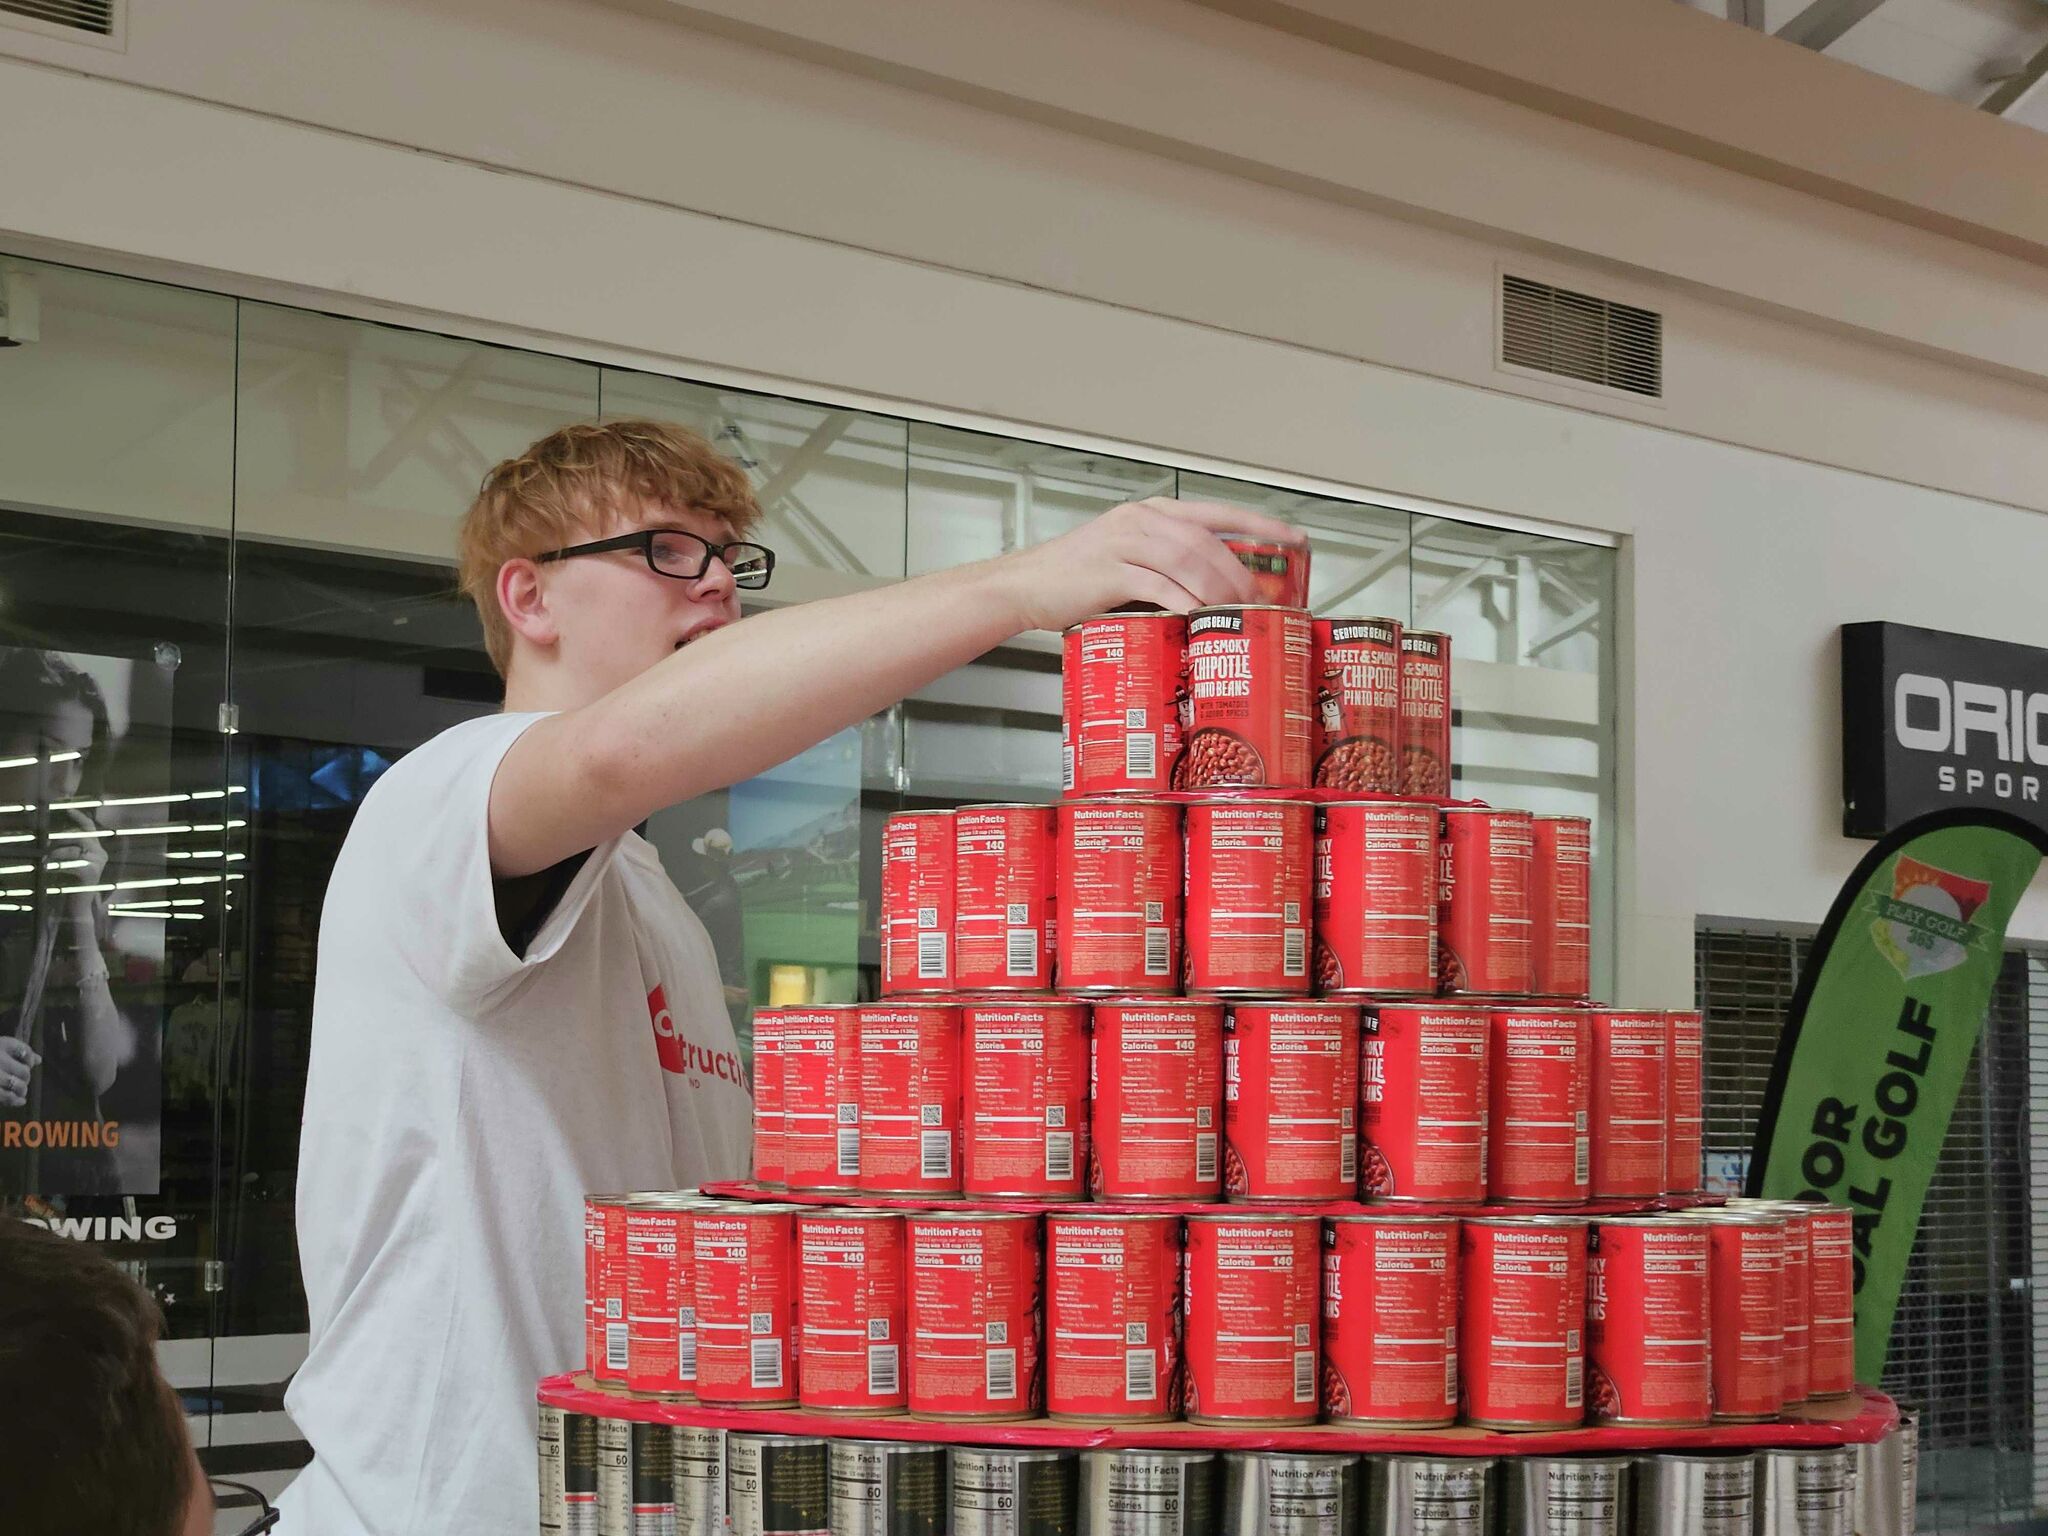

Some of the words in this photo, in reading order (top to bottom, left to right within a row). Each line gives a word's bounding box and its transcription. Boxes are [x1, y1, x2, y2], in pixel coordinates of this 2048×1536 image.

[1212, 616, 1231, 629] BEAN
[1369, 627, 1386, 641] BEAN
[1213, 639, 1251, 654] SMOKY
[1106, 648, 1124, 657] 140
[1324, 650, 1359, 663] SWEET
[1194, 655, 1253, 680] CHIPOTLE
[1342, 665, 1399, 692] CHIPOTLE
[1194, 681, 1216, 699] PINTO
[1216, 680, 1250, 697] BEANS
[1344, 690, 1372, 706] PINTO
[1374, 691, 1398, 708] BEANS
[980, 815, 1005, 824] Facts
[1074, 811, 1115, 819] Nutrition
[1115, 810, 1144, 819] Facts
[1211, 811, 1255, 819] Nutrition
[1256, 811, 1283, 819] Facts
[1365, 812, 1409, 822] Nutrition
[1409, 813, 1429, 822] Facts
[985, 841, 1005, 850] 140
[1074, 838, 1107, 846] Calories
[1122, 836, 1143, 846] 140
[1211, 838, 1247, 847] Calories
[1263, 836, 1282, 846] 140
[1365, 840, 1402, 849] Calories
[1415, 841, 1429, 850] 140
[901, 847, 916, 856] 140
[1490, 846, 1520, 854] Calories
[1886, 902, 1924, 924] PLAY
[1925, 916, 1968, 938] GOLF
[809, 1014, 835, 1023] Facts
[891, 1013, 919, 1022] Facts
[975, 1013, 1014, 1021] Nutrition
[1014, 1013, 1044, 1022] Facts
[1121, 1012, 1168, 1022] Nutrition
[1168, 1013, 1196, 1022] Facts
[1270, 1013, 1317, 1022] Nutrition
[1317, 1013, 1342, 1022] Facts
[1420, 1016, 1465, 1025] Nutrition
[1465, 1016, 1485, 1025] Facts
[1507, 1019, 1552, 1027] Nutrition
[1552, 1020, 1577, 1028] Facts
[1611, 1019, 1650, 1027] Nutrition
[815, 1040, 834, 1050] 140
[897, 1040, 918, 1050] 140
[975, 1041, 1005, 1050] Calories
[1021, 1039, 1043, 1050] 140
[1121, 1042, 1158, 1050] Calories
[1175, 1040, 1195, 1050] 140
[1270, 1043, 1308, 1051] Calories
[1323, 1041, 1341, 1051] 140
[1420, 1045, 1457, 1053] Calories
[1469, 1044, 1483, 1053] 140
[1506, 1047, 1544, 1055] Calories
[1559, 1046, 1576, 1055] 140
[1610, 1047, 1645, 1055] Calories
[1862, 996, 1937, 1159] GOLF
[651, 1217, 677, 1226] Facts
[720, 1221, 747, 1230] Facts
[803, 1224, 835, 1234] Nutrition
[836, 1225, 864, 1235] Facts
[915, 1226, 953, 1236] Nutrition
[953, 1227, 983, 1236] Facts
[1056, 1225, 1094, 1235] Nutrition
[1094, 1226, 1124, 1236] Facts
[1218, 1228, 1265, 1237] Nutrition
[1265, 1228, 1294, 1238] Facts
[1375, 1230, 1423, 1239] Nutrition
[1423, 1231, 1447, 1240] Facts
[1493, 1232, 1541, 1242] Nutrition
[1541, 1234, 1568, 1244] Facts
[1643, 1233, 1688, 1242] Nutrition
[655, 1243, 676, 1253] 140
[725, 1248, 747, 1258] 140
[803, 1253, 828, 1262] Calories
[842, 1252, 864, 1263] 140
[915, 1256, 944, 1264] Calories
[960, 1255, 982, 1264] 140
[1056, 1256, 1085, 1264] Calories
[1100, 1254, 1123, 1264] 140
[1218, 1257, 1255, 1266] Calories
[1272, 1256, 1293, 1266] 140
[1375, 1260, 1415, 1269] Calories
[1429, 1259, 1446, 1269] 140
[1493, 1262, 1532, 1272] Calories
[1548, 1262, 1568, 1272] 140
[1643, 1262, 1681, 1271] Calories
[608, 1424, 628, 1433] Facts
[698, 1433, 720, 1443] Facts
[550, 1445, 560, 1455] 60
[738, 1446, 757, 1457] Facts
[616, 1455, 628, 1465] 60
[857, 1453, 882, 1464] Facts
[707, 1465, 720, 1476] 60
[987, 1464, 1013, 1473] Facts
[1109, 1463, 1151, 1474] Nutrition
[1154, 1465, 1180, 1475] Facts
[1271, 1468, 1314, 1478] Nutrition
[1414, 1471, 1457, 1482] Nutrition
[1548, 1471, 1591, 1482] Nutrition
[1593, 1472, 1615, 1481] Facts
[746, 1479, 757, 1490] 60
[867, 1487, 881, 1498] 60
[997, 1496, 1013, 1508] 60
[1109, 1499, 1142, 1510] Calories
[1164, 1499, 1178, 1510] 60
[1270, 1504, 1306, 1515] Calories
[1325, 1502, 1338, 1514] 60
[1414, 1507, 1450, 1517] Calories
[1468, 1504, 1480, 1516] 60
[1547, 1507, 1584, 1517] Calories
[1602, 1504, 1614, 1517] 60
